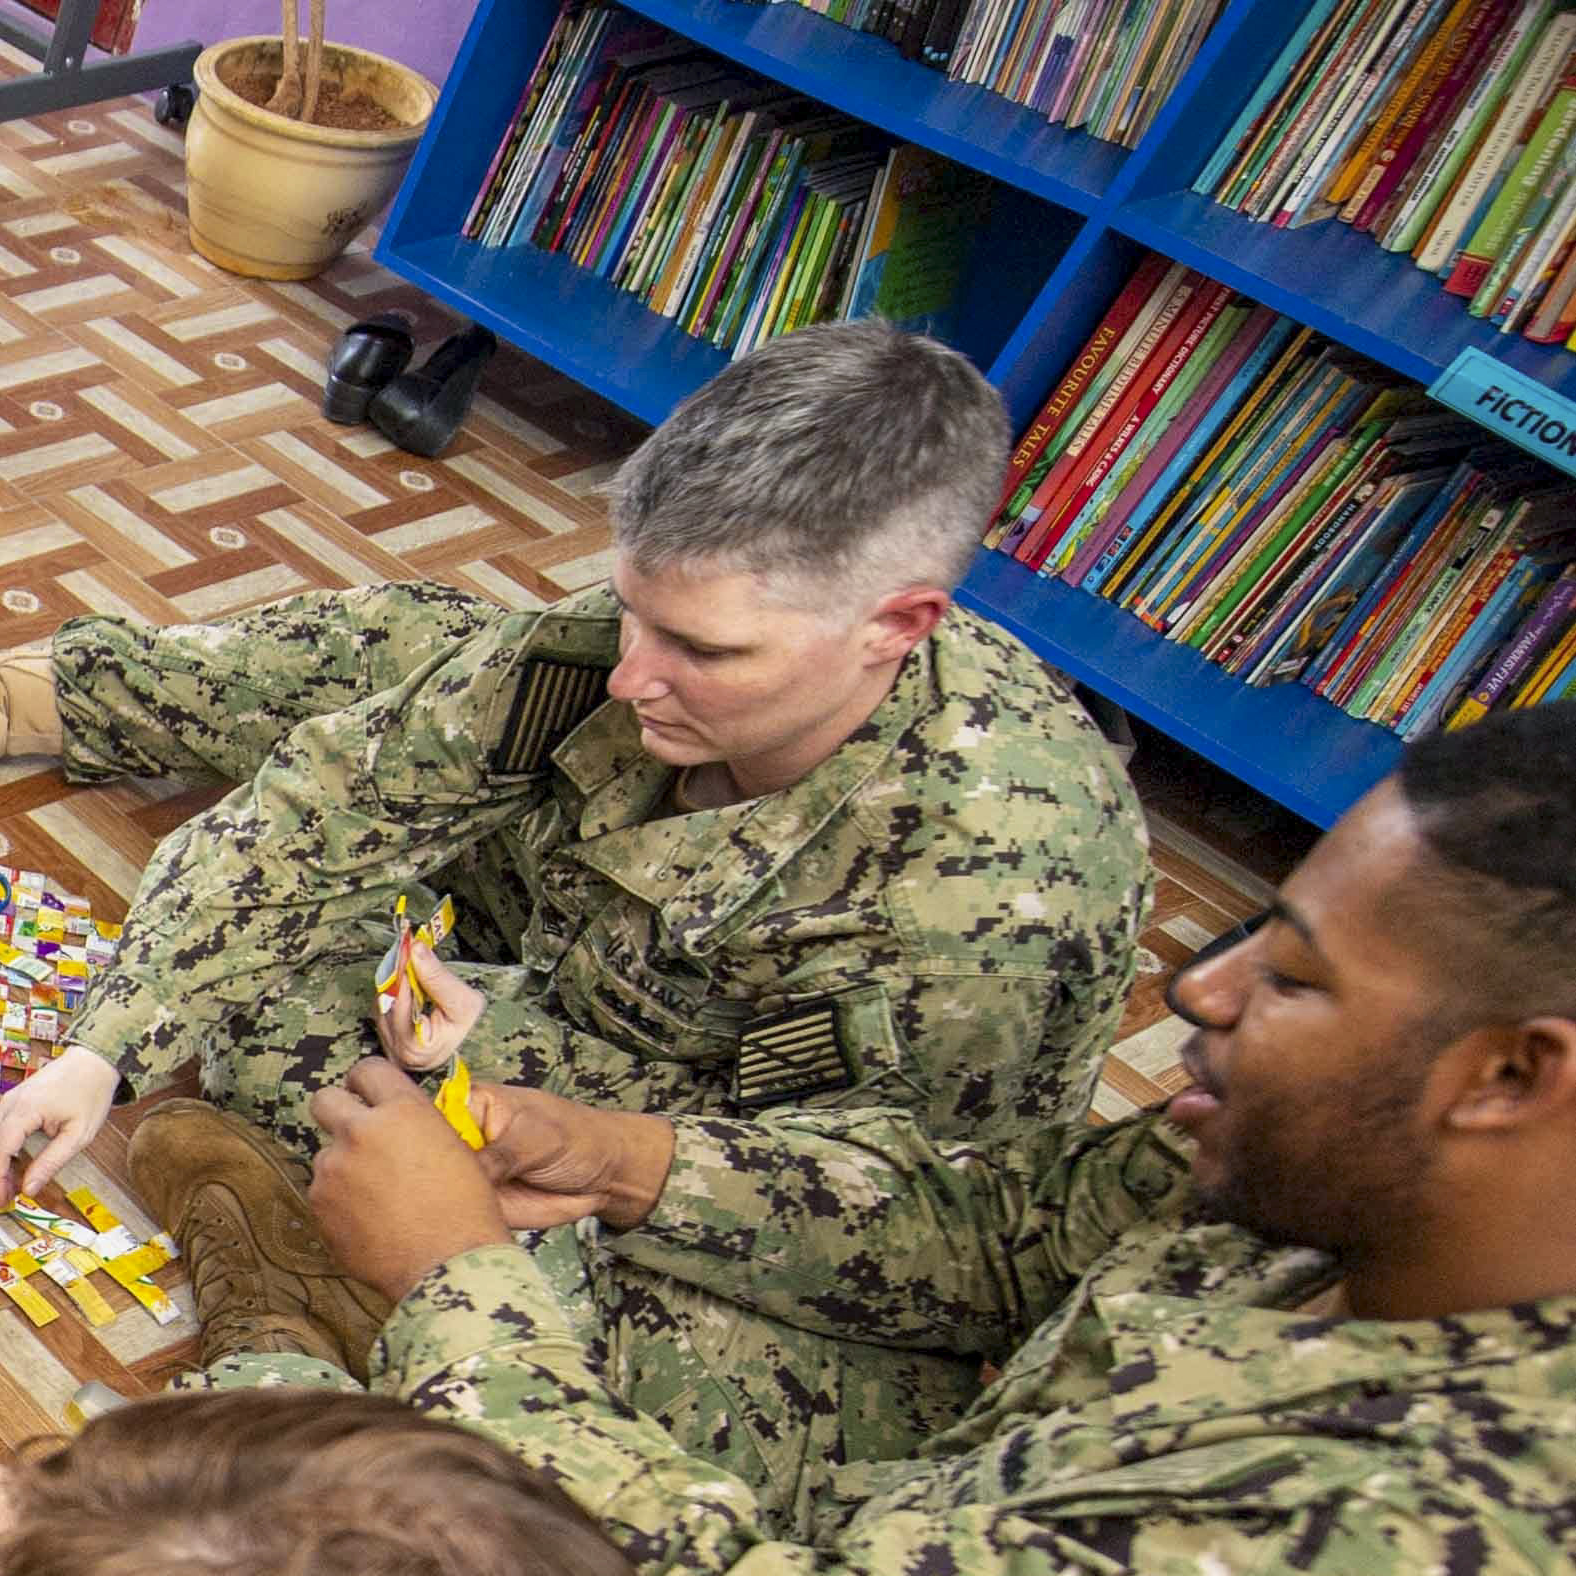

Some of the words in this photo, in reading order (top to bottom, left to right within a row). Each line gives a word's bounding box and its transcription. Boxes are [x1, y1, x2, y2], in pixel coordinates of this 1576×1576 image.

[1136, 299, 1180, 356] MINUTE
[1182, 310, 1213, 348] PICTURE
[1045, 324, 1116, 418] FAVOURITE
[1096, 355, 1141, 413] BEDTIME
[1149, 344, 1189, 395] DICTIONARY
[1010, 420, 1050, 469] TALES
[1069, 410, 1103, 452] TALES
[1310, 498, 1356, 554] HANDBOOK
[1502, 629, 1537, 671] FAMOUS
[1484, 665, 1510, 695] FIVE
